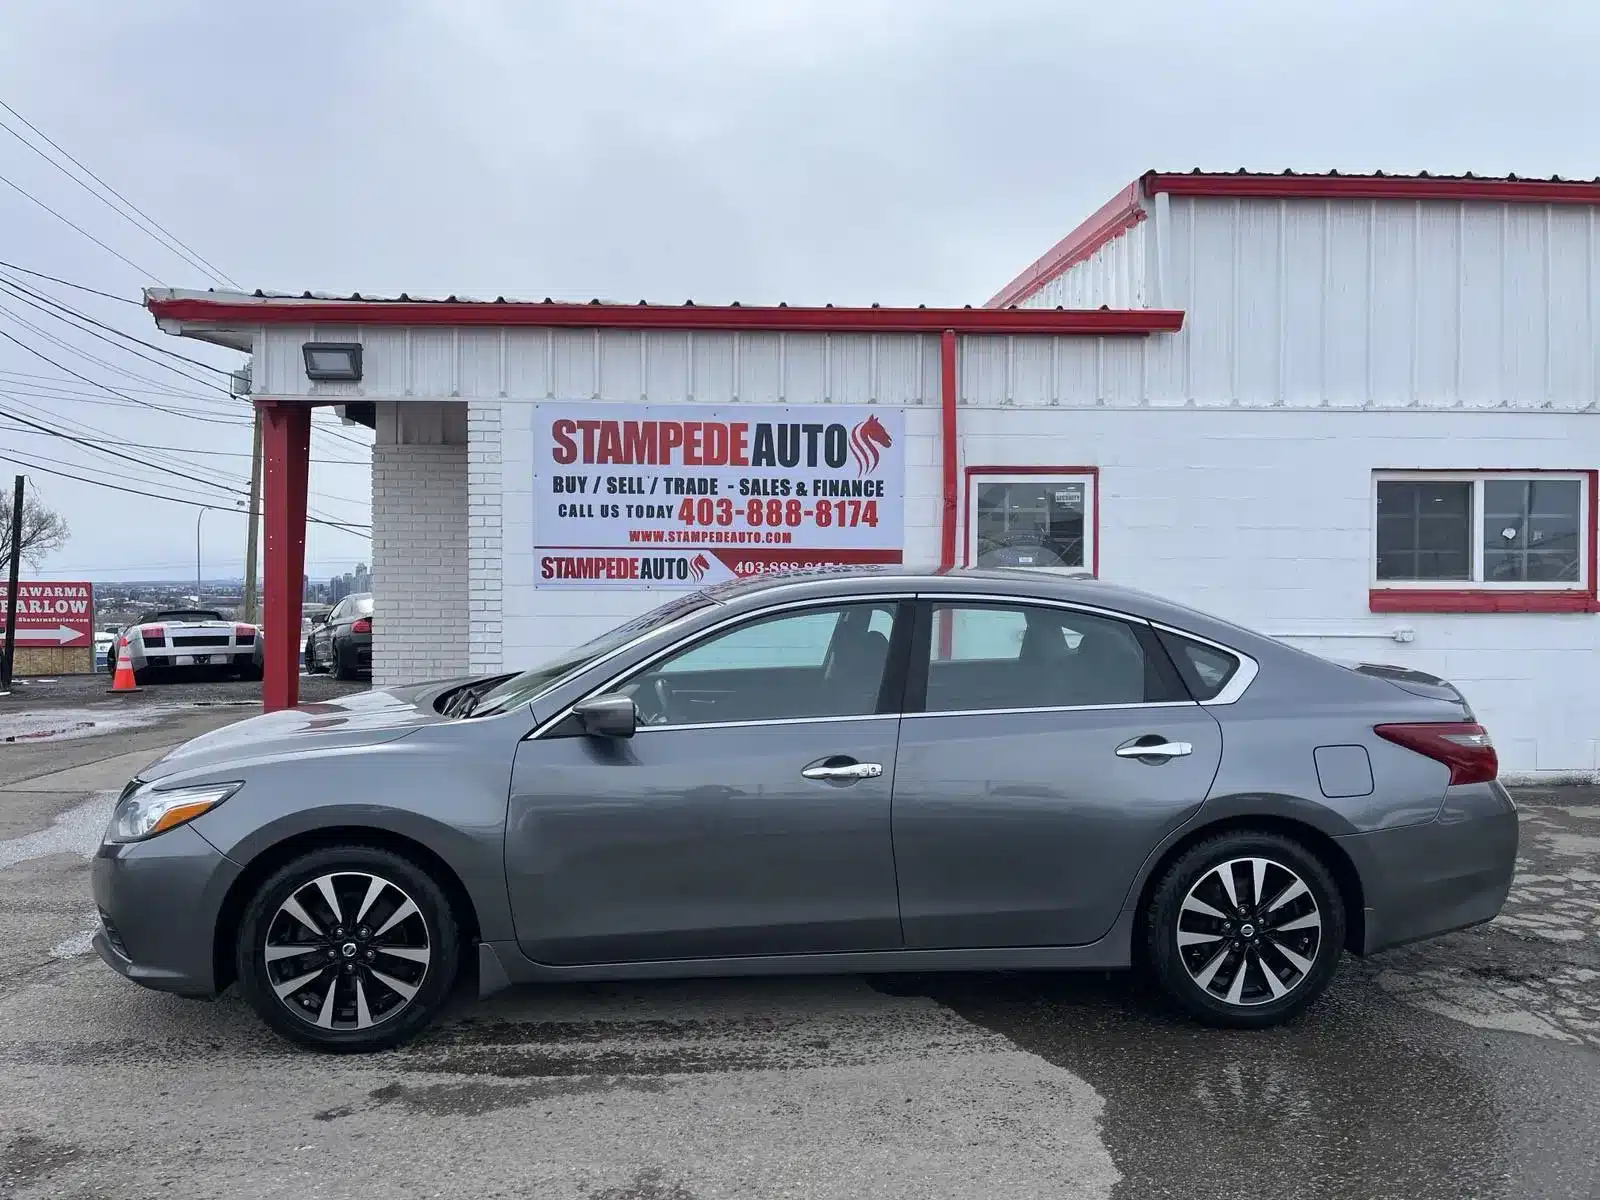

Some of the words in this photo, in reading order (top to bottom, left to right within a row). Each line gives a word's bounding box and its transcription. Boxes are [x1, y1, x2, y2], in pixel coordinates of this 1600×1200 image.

[552, 476, 587, 494] BUY
[592, 476, 602, 494] /
[606, 477, 645, 494] SELL
[663, 478, 719, 495] TRADE
[739, 478, 791, 496] SALES
[796, 482, 808, 496] &
[813, 480, 884, 497] FINANCE
[558, 504, 594, 518] CALL
[600, 504, 620, 518] US
[626, 505, 674, 518] TODAY
[678, 497, 878, 528] 403-888-8174
[629, 531, 792, 543] WWW.STAMPEDEAUTO.COM
[0, 587, 88, 597] SAWARMA
